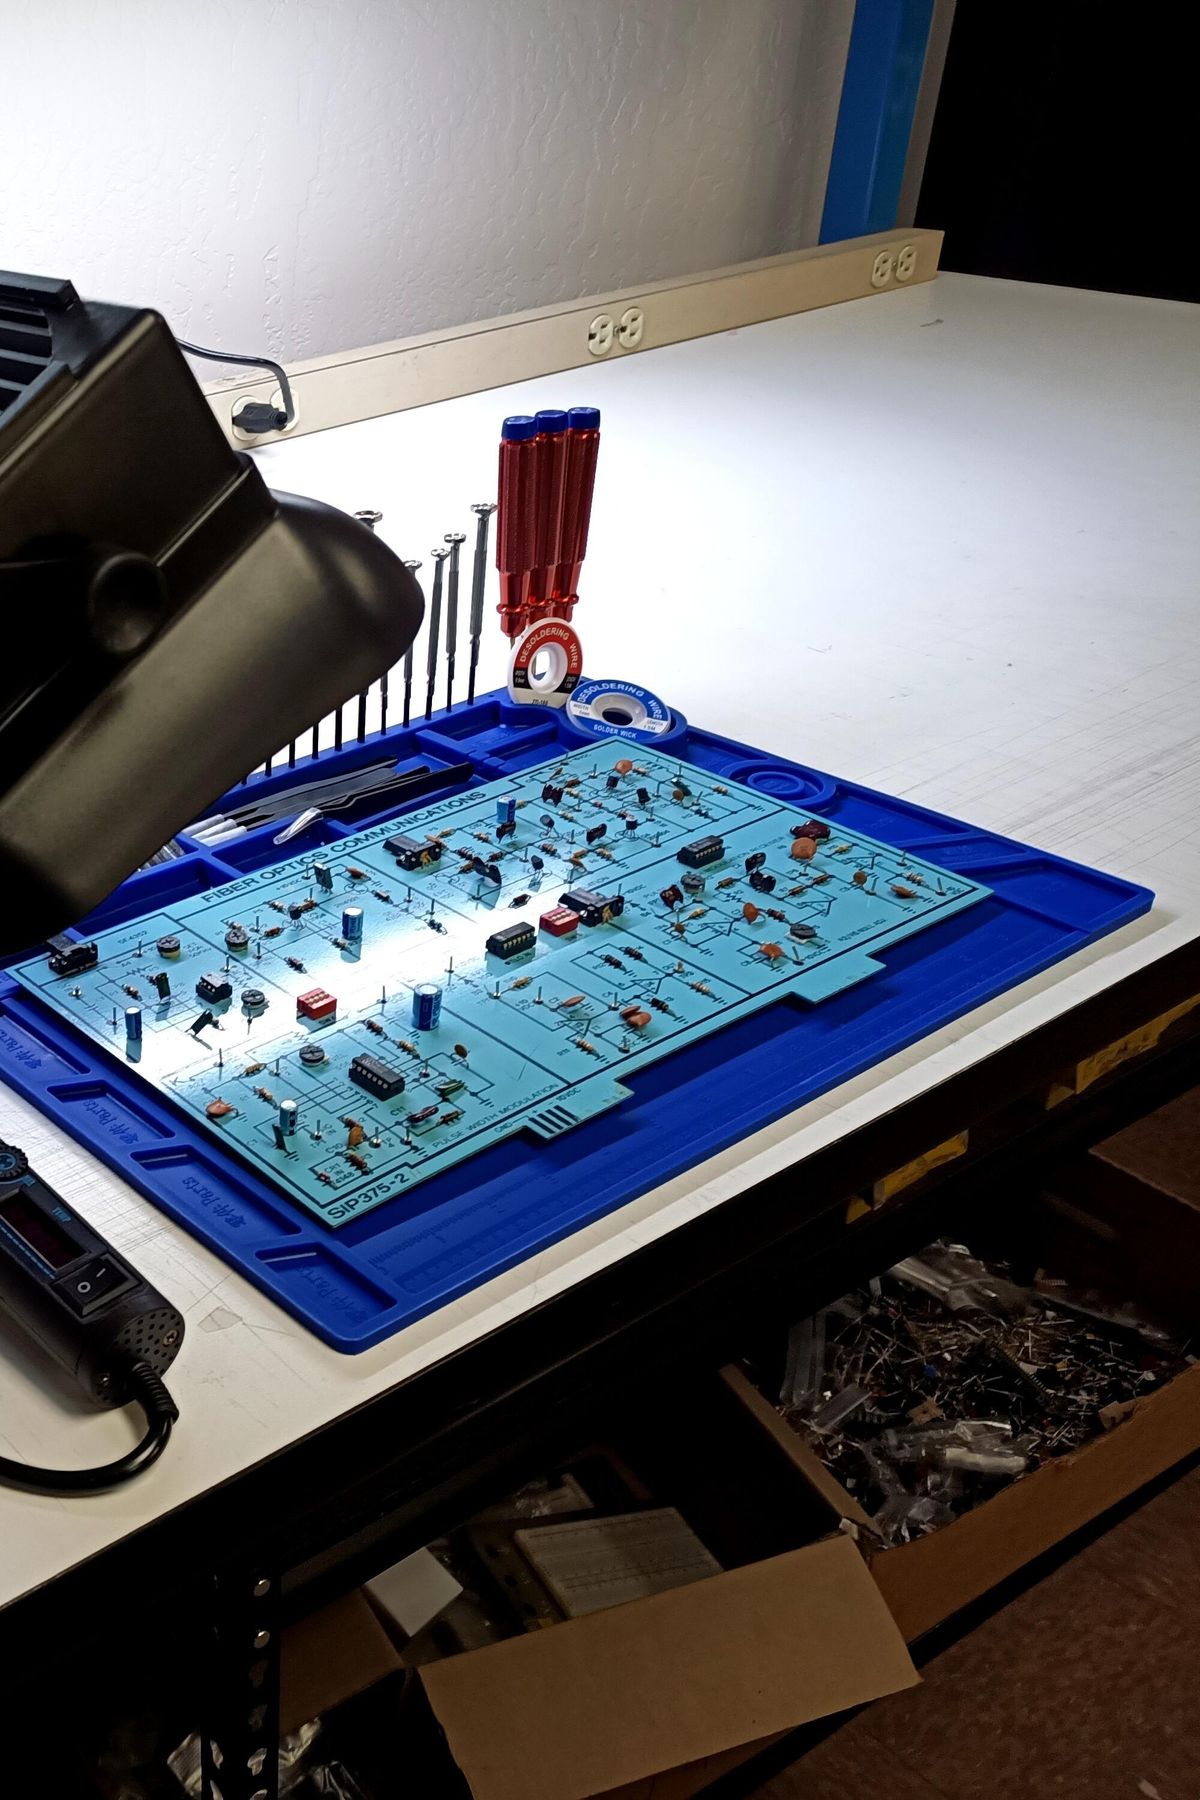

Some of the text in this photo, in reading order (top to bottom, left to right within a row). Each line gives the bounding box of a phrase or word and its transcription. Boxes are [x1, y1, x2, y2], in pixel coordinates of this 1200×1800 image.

[520, 627, 579, 668] DESOLDERING WIRE
[577, 682, 663, 720] DESOLDERING WIRE
[593, 724, 637, 739] SOLDER WICK
[201, 789, 487, 904] FIBER OPTICS COMMUNICATIONS
[432, 1083, 559, 1149] PULSE WIDTH MODULATION
[327, 1172, 410, 1219] SIP375-2
